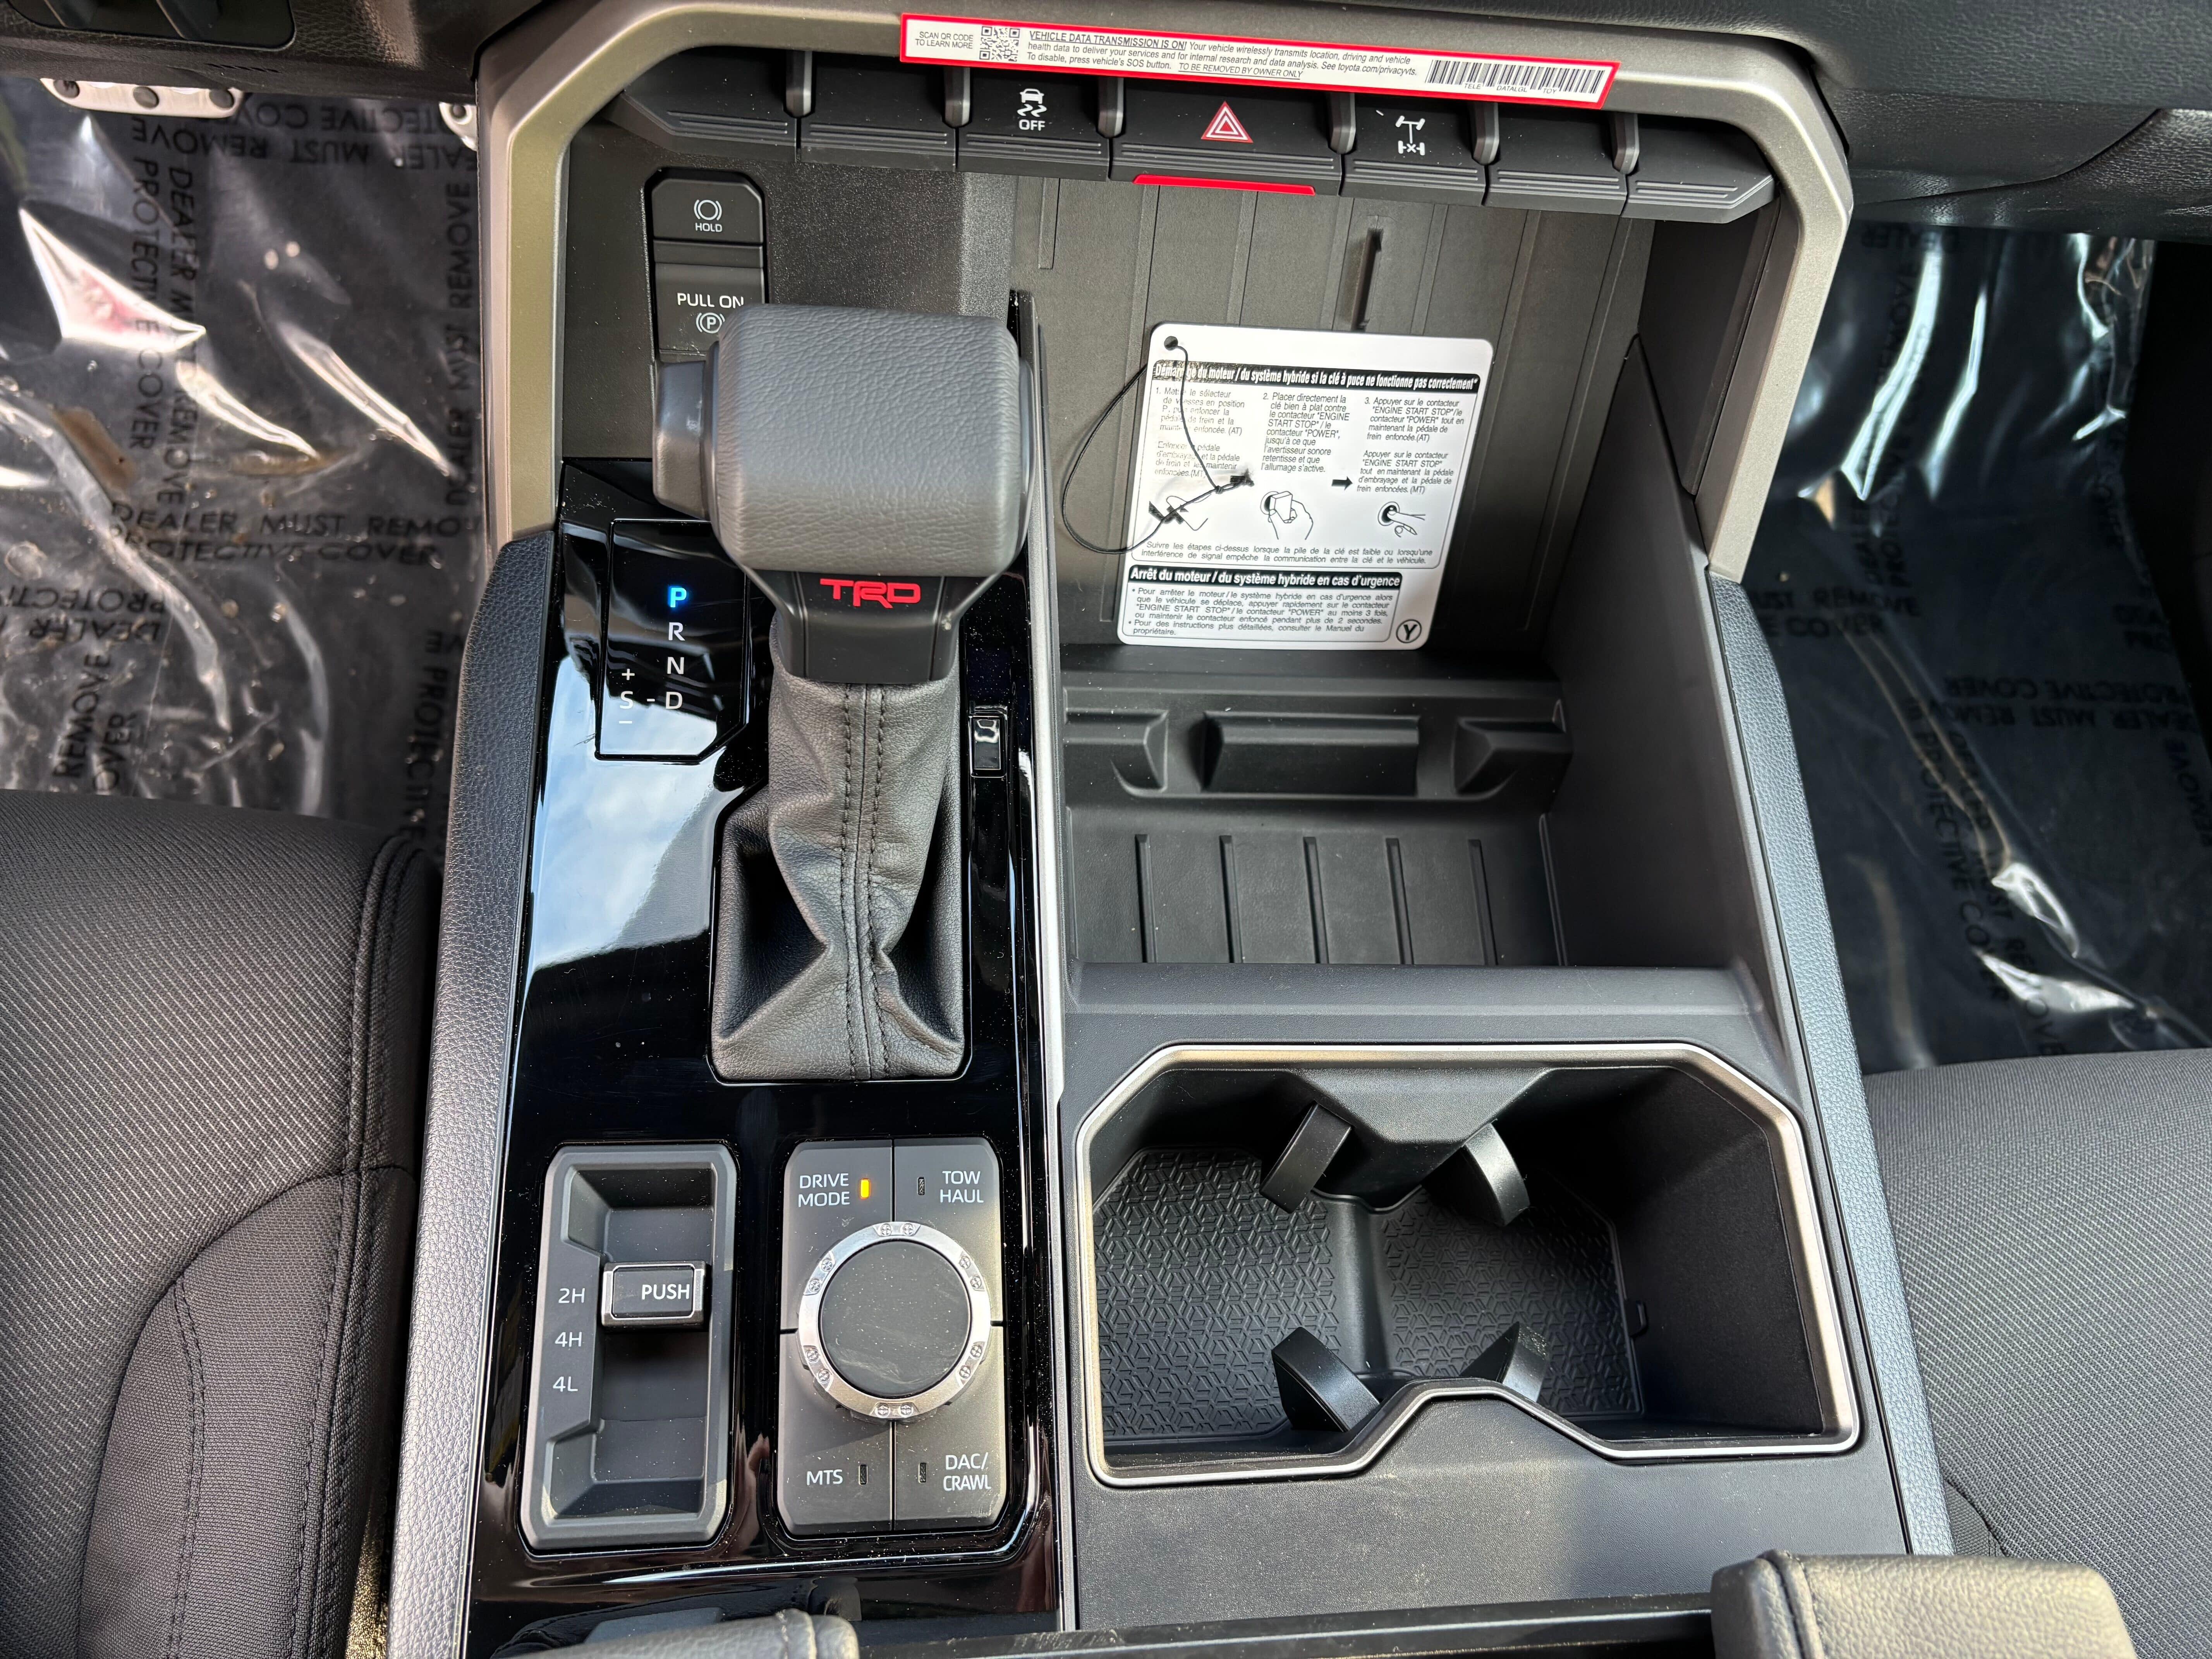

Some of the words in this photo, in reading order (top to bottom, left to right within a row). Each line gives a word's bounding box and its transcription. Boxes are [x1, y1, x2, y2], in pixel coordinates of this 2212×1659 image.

[915, 38, 925, 46] TO
[926, 39, 950, 48] LEARN
[951, 41, 973, 49] MORE
[919, 31, 939, 39] SCAN
[953, 33, 974, 42] CODE
[1029, 30, 1067, 42] VEHICLE
[1068, 33, 1091, 43] DATA
[1094, 35, 1159, 48] TRANSMISSION
[1160, 39, 1169, 48] IS
[1189, 41, 1207, 51] Your
[1208, 43, 1234, 53] vehicle
[1236, 45, 1273, 57] wirelessly
[1274, 48, 1308, 58] transmits
[1309, 50, 1340, 61] location,
[1342, 52, 1367, 63] driving
[1368, 54, 1384, 63] and
[1385, 55, 1411, 65] vehicle
[1027, 41, 1051, 51] health
[1053, 43, 1070, 52] data
[1072, 45, 1080, 53] to
[1082, 45, 1108, 55] deliver
[1108, 48, 1127, 57] your
[1128, 49, 1159, 58] services
[1161, 51, 1176, 59] and
[1177, 52, 1188, 60] for
[1189, 52, 1218, 62] internal
[1219, 56, 1251, 64] research
[1253, 57, 1268, 65] and
[1269, 57, 1286, 67] data
[1286, 60, 1319, 69] analysis.
[1321, 61, 1336, 70] See
[1339, 62, 1417, 76] toyota.com/privacyvts.
[1027, 51, 1036, 60] To
[1037, 52, 1066, 64] disable,
[1068, 56, 1090, 64] press
[1092, 57, 1124, 66] vehicle's
[1126, 58, 1144, 67] SOS
[1146, 60, 1171, 69] button.
[1179, 62, 1189, 70] TO
[1190, 63, 1201, 71] BE
[1202, 64, 1240, 74] REMOVED
[1253, 67, 1282, 76] OWNER
[1283, 69, 1304, 78] ONLY
[1019, 119, 1045, 131] OFF
[695, 222, 722, 232] HOLD
[677, 293, 715, 307] PULL
[719, 295, 744, 309] ON
[1155, 364, 1196, 380] Démarrge
[1197, 368, 1208, 378] du
[1208, 369, 1235, 380] moteur
[1240, 370, 1249, 381] du
[1251, 370, 1281, 383] système
[1283, 371, 1310, 385] hybride
[1310, 373, 1319, 384] si
[1319, 373, 1327, 384] la
[1328, 373, 1340, 385] clé
[1340, 373, 1346, 384] à
[1346, 374, 1364, 388] puce
[1365, 376, 1375, 386] ne
[1376, 374, 1413, 388] fonctionne
[1413, 378, 1427, 390] pas
[1262, 392, 1269, 400] 2.
[1272, 392, 1295, 401] Placer
[1296, 393, 1338, 403] directement
[1340, 394, 1346, 404] la
[1372, 397, 1402, 407] Appuyer
[1417, 398, 1424, 406] le
[1426, 399, 1460, 407] contacteur
[1269, 410, 1276, 418] le
[1277, 411, 1315, 419] contacteur
[1270, 401, 1281, 410] clé
[1283, 402, 1299, 410] bien
[1301, 402, 1307, 410] à
[1309, 403, 1323, 412] plat
[1324, 404, 1346, 412] contre
[1405, 407, 1429, 415] START
[1267, 418, 1293, 428] START
[1324, 421, 1331, 429] le
[1266, 428, 1303, 438] contacteur
[1263, 445, 1306, 454] l'avertisseur
[1264, 436, 1290, 446] jusqu'à
[1302, 439, 1316, 447] que
[1260, 462, 1297, 473] l'allumage
[1297, 464, 1326, 472] s'active.
[1262, 454, 1297, 463] retentisse
[1298, 455, 1305, 463] et
[1306, 457, 1320, 465] que
[1130, 568, 1157, 580] Arrêt
[1158, 569, 1173, 580] du
[1174, 571, 1212, 582] moteur
[1218, 572, 1233, 583] du
[1233, 573, 1277, 586] système
[1277, 573, 1316, 587] hybride
[1317, 577, 1330, 586] en
[1331, 577, 1350, 586] cas
[1352, 574, 1400, 589] d'urgence
[670, 586, 687, 608] P
[820, 578, 921, 608] TRD
[668, 622, 685, 641] R
[1132, 627, 1176, 635] propriétaire.
[1403, 624, 1418, 641] Y
[667, 656, 684, 674] N
[619, 691, 634, 710] S
[665, 691, 683, 710] D
[799, 1173, 849, 1188] DRIVE
[942, 1171, 981, 1184] TOW
[798, 1191, 850, 1207] MODE
[940, 1189, 984, 1203] HAUL
[558, 1288, 586, 1304] 2H
[641, 1284, 690, 1300] PUSH
[554, 1331, 582, 1348] 4H
[552, 1376, 578, 1393] 4L
[946, 1452, 989, 1471] DAC/
[807, 1469, 843, 1486] MTS
[943, 1474, 992, 1491] CRAWL
